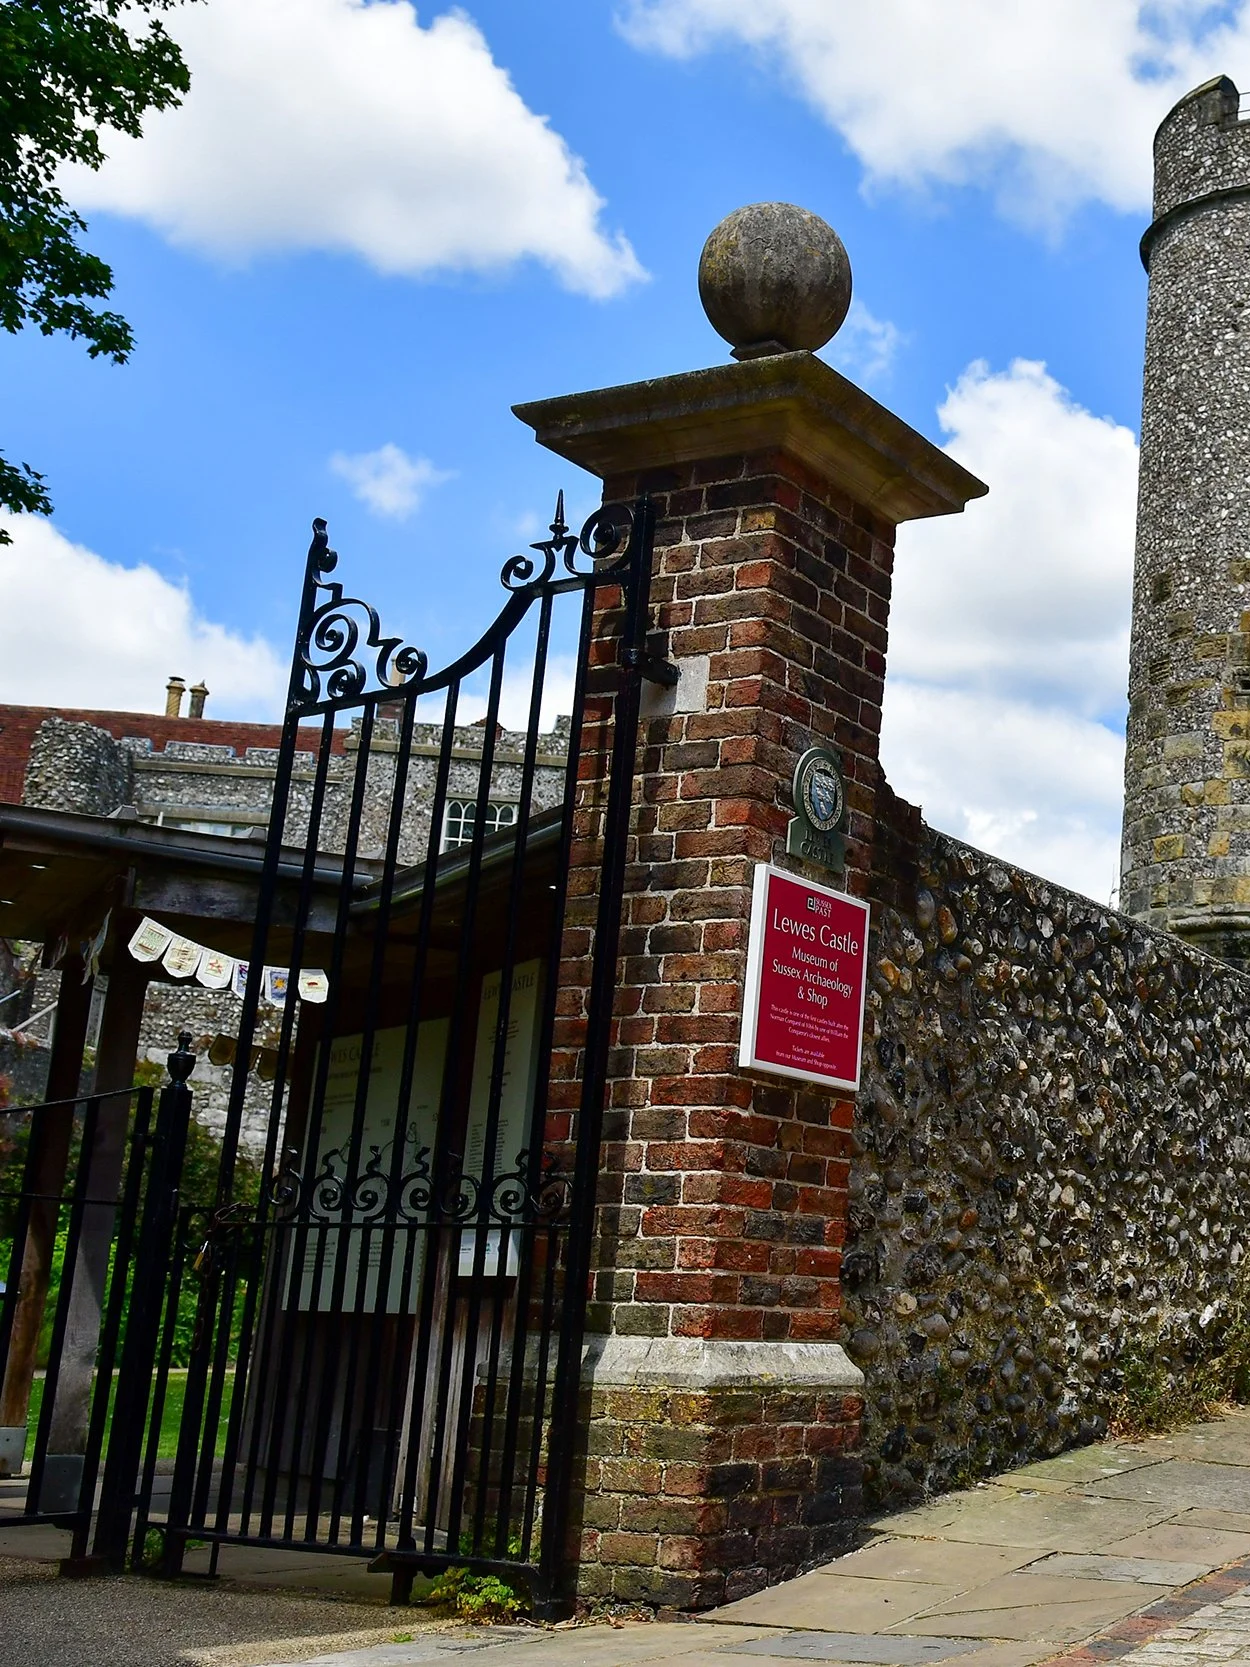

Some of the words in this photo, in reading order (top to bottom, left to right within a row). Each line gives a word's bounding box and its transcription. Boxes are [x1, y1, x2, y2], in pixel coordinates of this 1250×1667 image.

[815, 906, 832, 918] PAST
[773, 907, 816, 942] Lewes
[819, 924, 859, 956] Castle
[792, 946, 828, 969] Museum
[829, 958, 839, 972] of
[772, 958, 801, 979] Sussex
[802, 968, 853, 999] Archaeology
[797, 985, 805, 1000] &
[807, 988, 828, 1010] Shop
